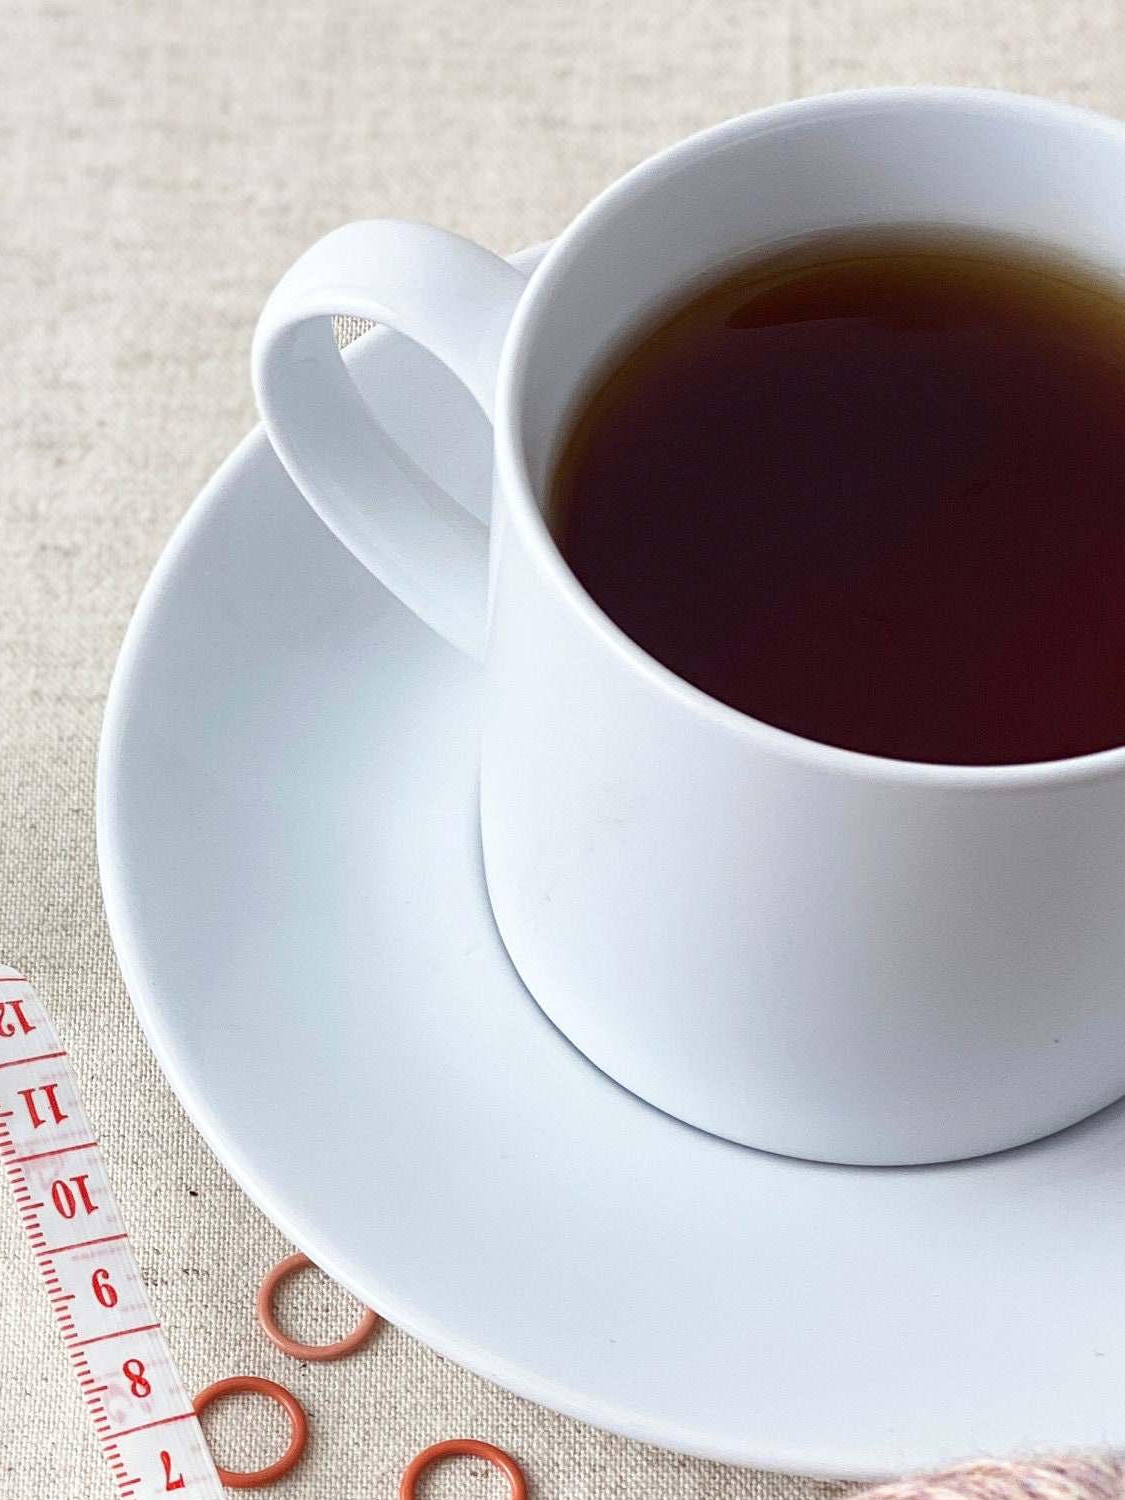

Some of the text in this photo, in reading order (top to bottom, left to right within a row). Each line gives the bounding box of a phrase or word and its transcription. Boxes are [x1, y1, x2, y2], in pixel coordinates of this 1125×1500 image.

[17, 1083, 68, 1129] 11
[51, 1174, 98, 1219] 10
[91, 1268, 118, 1308] 9
[122, 1358, 151, 1398] 8
[159, 1450, 186, 1491] 7
